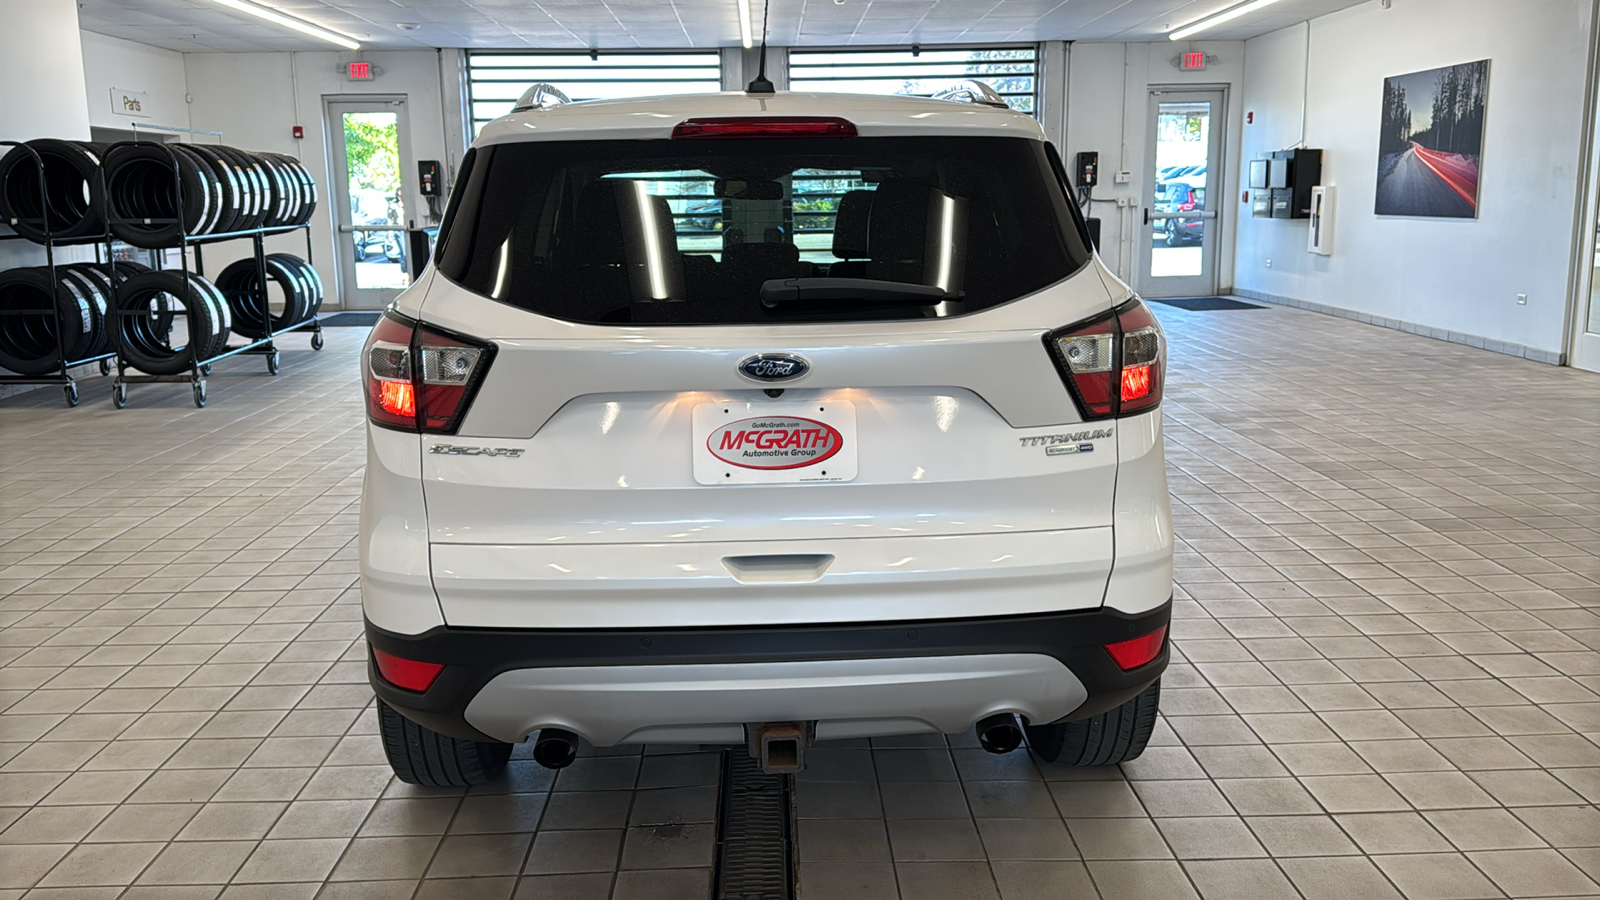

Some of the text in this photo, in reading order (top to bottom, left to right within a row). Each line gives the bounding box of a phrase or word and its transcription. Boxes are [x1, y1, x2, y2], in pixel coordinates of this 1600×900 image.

[1184, 52, 1204, 67] EXIT
[350, 62, 369, 78] EXIT
[123, 95, 142, 112] Parts
[755, 359, 795, 376] Ford
[751, 421, 800, 429] GoMcGrath.com
[1019, 428, 1114, 447] TITANIUM
[428, 443, 525, 457] ESCAPE
[742, 448, 817, 458] Automotive Group
